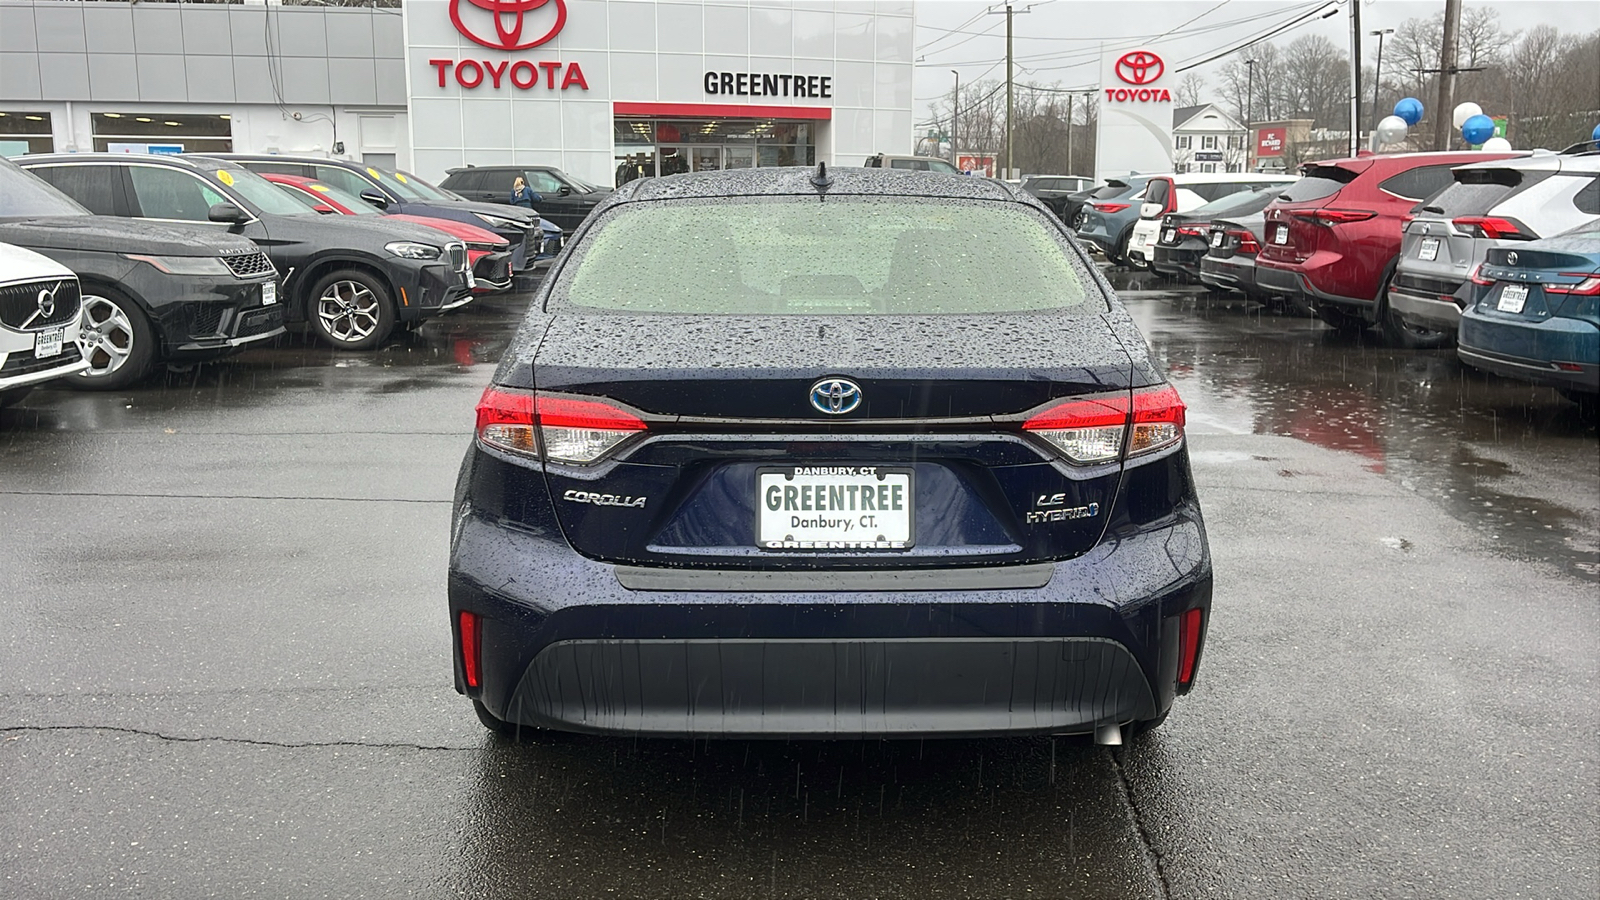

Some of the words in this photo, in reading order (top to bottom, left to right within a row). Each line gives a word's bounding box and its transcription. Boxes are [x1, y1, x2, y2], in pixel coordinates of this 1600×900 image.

[429, 59, 589, 90] TOYOTA
[704, 71, 832, 98] GREENTREE
[1105, 88, 1171, 103] TOYOTA
[794, 466, 857, 476] DANBURY,
[859, 466, 877, 475] CT
[563, 489, 647, 508] COROLLA
[765, 484, 903, 511] GREENTREE
[1037, 493, 1066, 506] LE
[791, 515, 855, 532] Danbury,
[859, 515, 878, 528] CT.
[1026, 506, 1090, 524] HYBRID
[765, 541, 905, 549] GREENTREE
